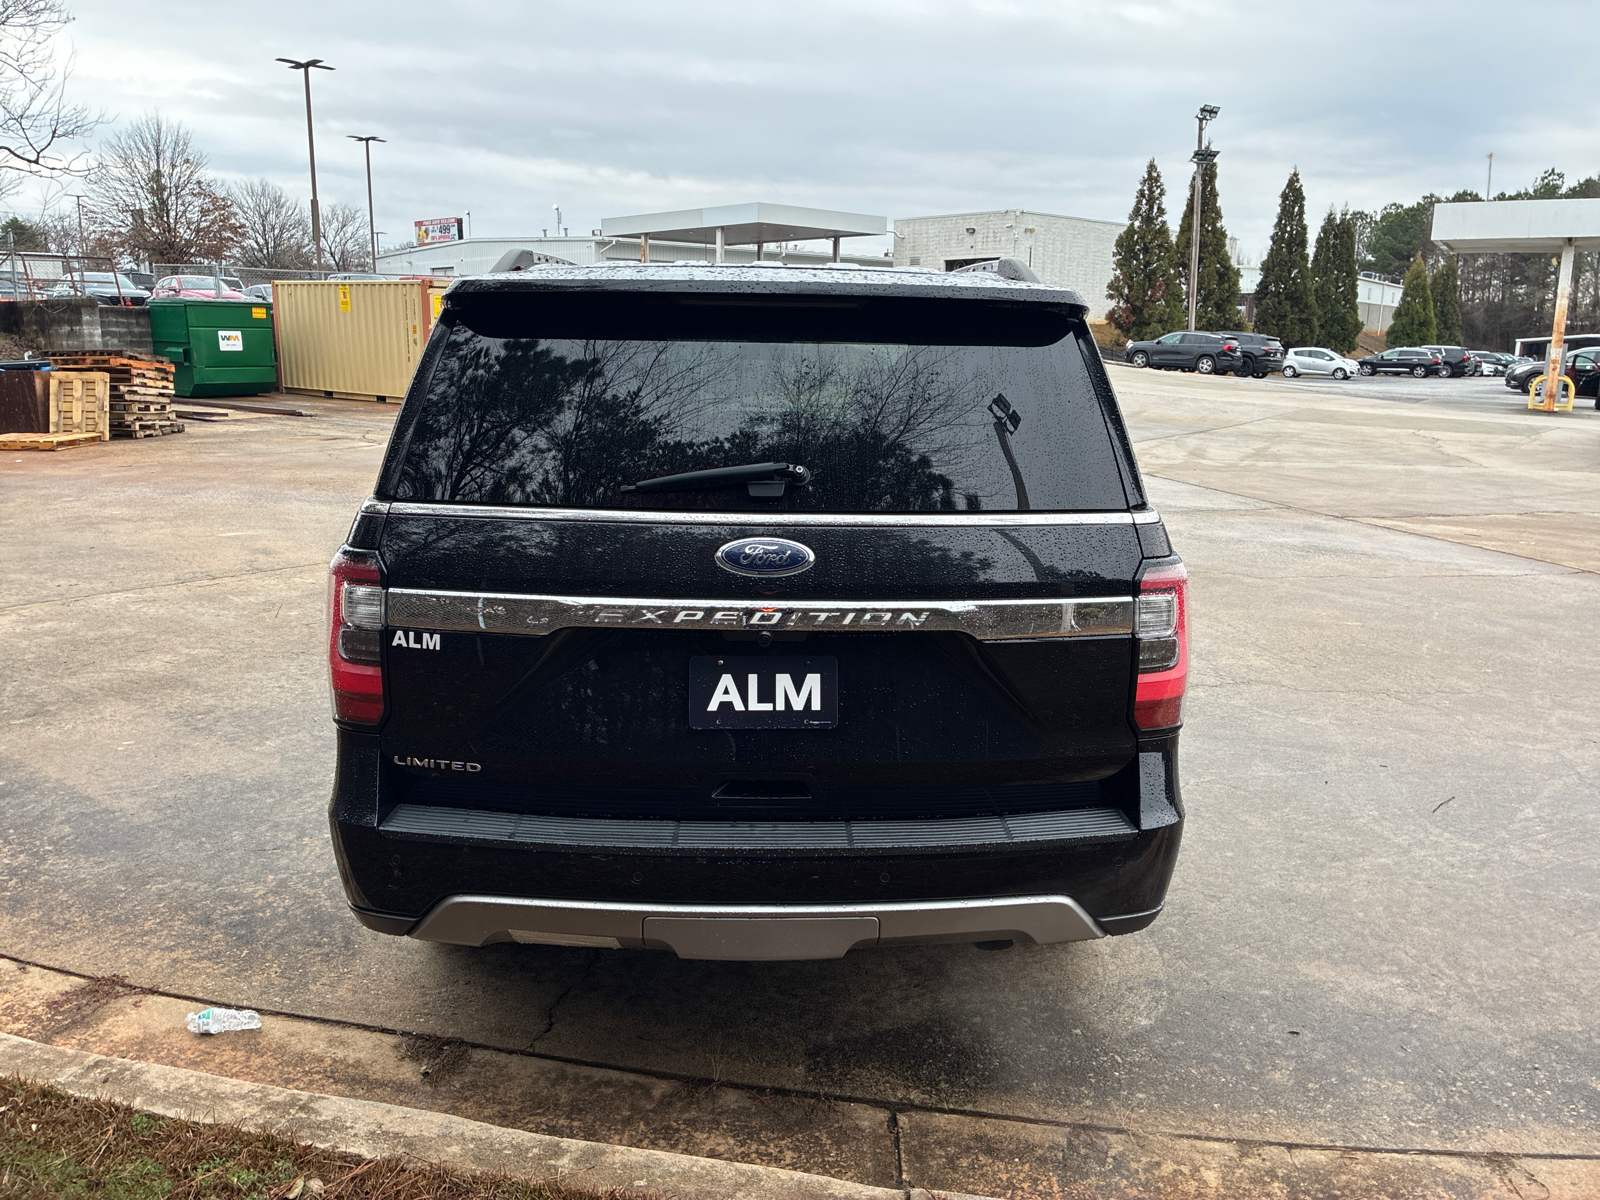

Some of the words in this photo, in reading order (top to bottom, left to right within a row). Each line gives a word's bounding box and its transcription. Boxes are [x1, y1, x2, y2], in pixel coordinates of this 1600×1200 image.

[739, 544, 791, 566] Ford
[594, 609, 930, 626] EXPEDITION
[391, 630, 441, 650] ALM
[706, 673, 821, 711] ALM
[393, 755, 482, 772] LIMITED
